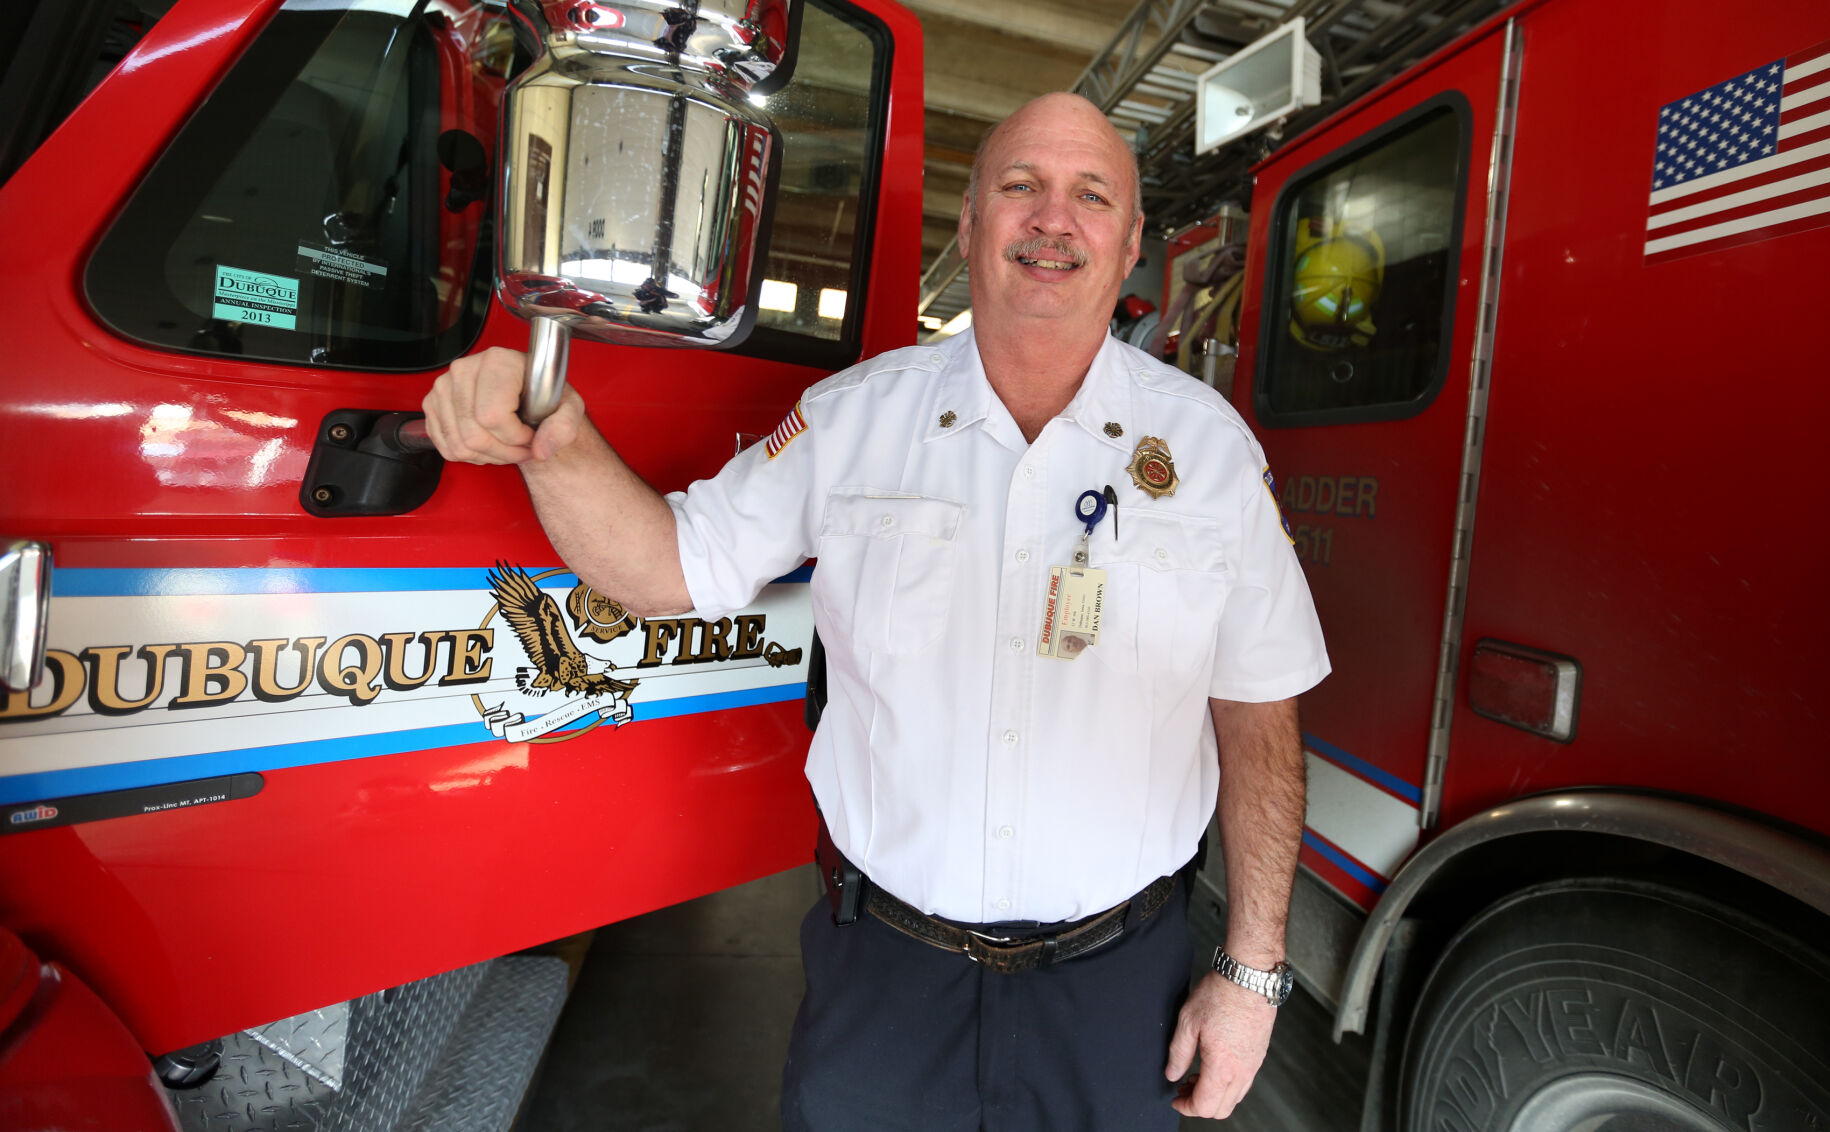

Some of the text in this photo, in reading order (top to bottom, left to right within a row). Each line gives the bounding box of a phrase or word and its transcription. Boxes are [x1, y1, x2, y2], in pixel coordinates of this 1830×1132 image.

[321, 253, 365, 269] PROTECTED
[324, 246, 365, 260] THIS VEHICLE
[311, 269, 370, 287] DETERRENT SYSTEM
[319, 265, 363, 280] PASSIVE THEFT
[220, 276, 297, 300] DUBUQUE
[220, 298, 293, 314] ANNUAL INSPECTION
[241, 310, 272, 323] 2013
[1281, 475, 1379, 520] ADDER
[1041, 574, 1060, 645] DUBUQUE FIRE
[1091, 583, 1104, 632] DAN BROWN
[590, 625, 623, 634] SERVICE
[0, 613, 767, 723] DUBUQUE FIRE
[520, 698, 601, 738] Fire Rescue EMS
[193, 794, 226, 805] APT-1014
